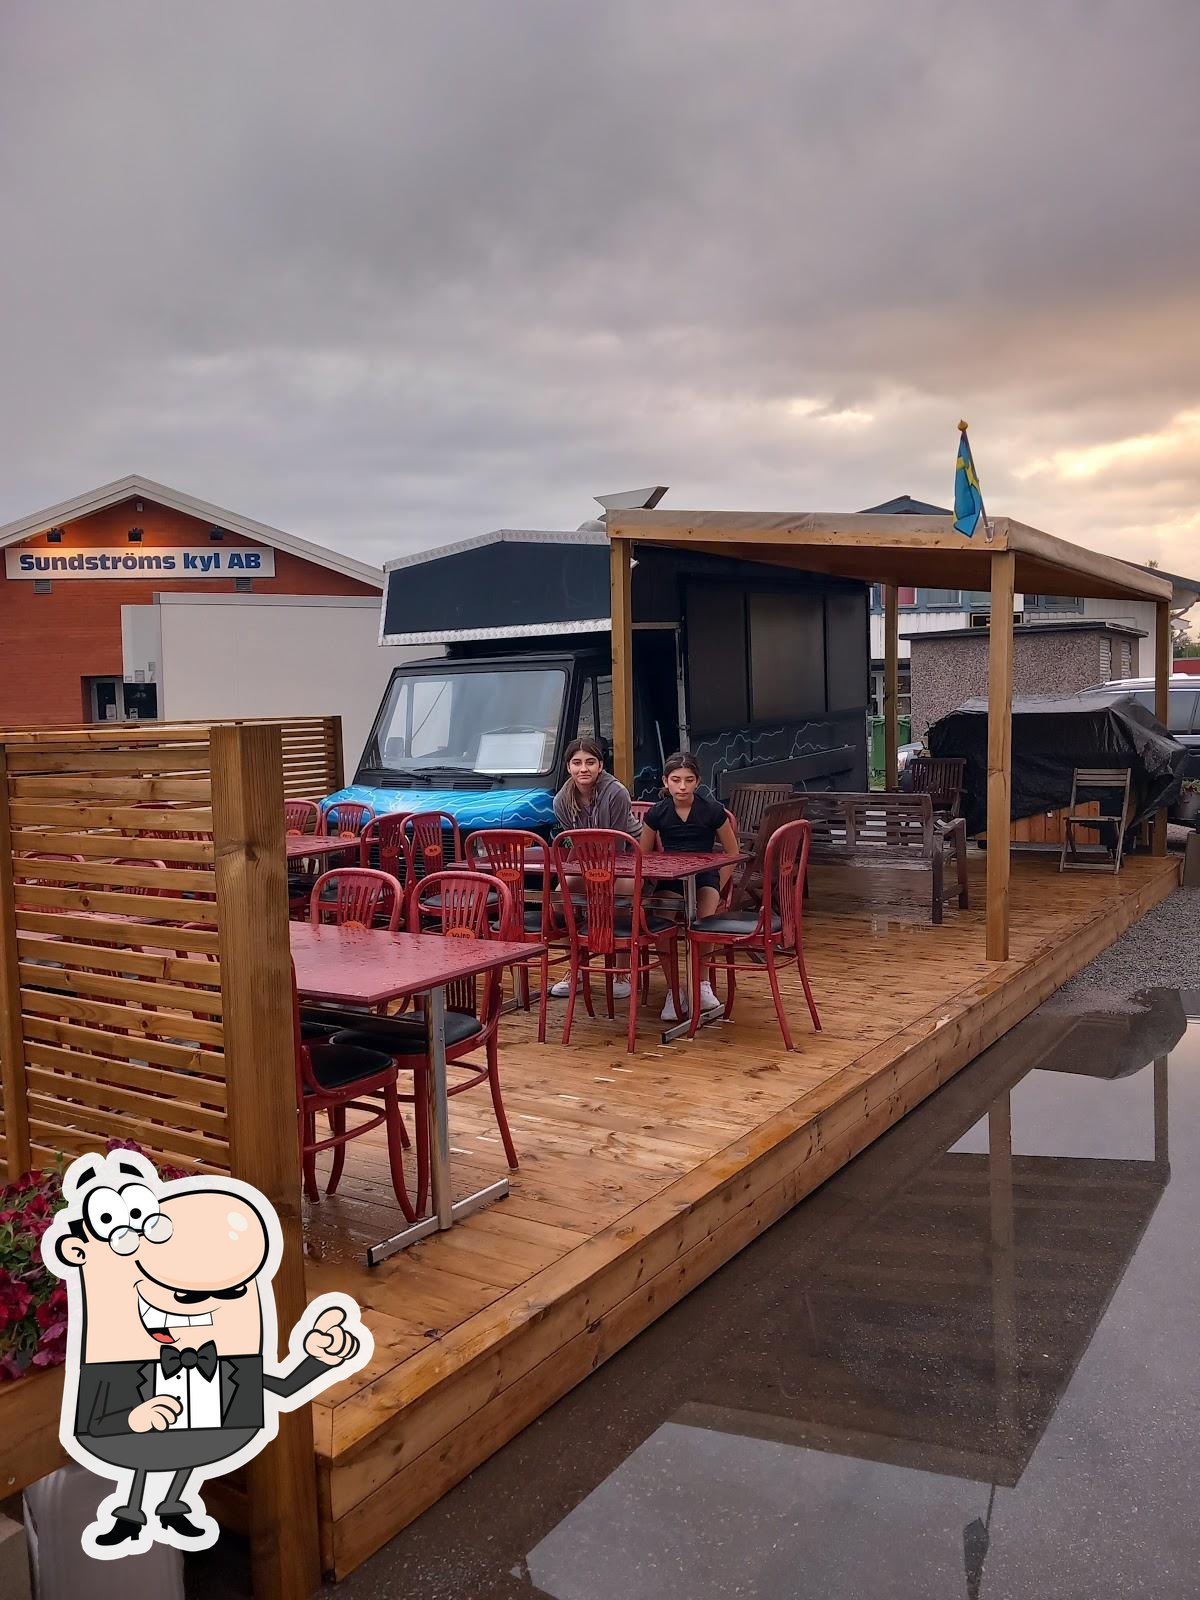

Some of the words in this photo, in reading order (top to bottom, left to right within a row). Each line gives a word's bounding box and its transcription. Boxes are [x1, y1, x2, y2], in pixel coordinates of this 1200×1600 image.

[20, 553, 176, 570] Sundströms
[183, 552, 221, 571] kyl
[227, 553, 261, 569] AB
